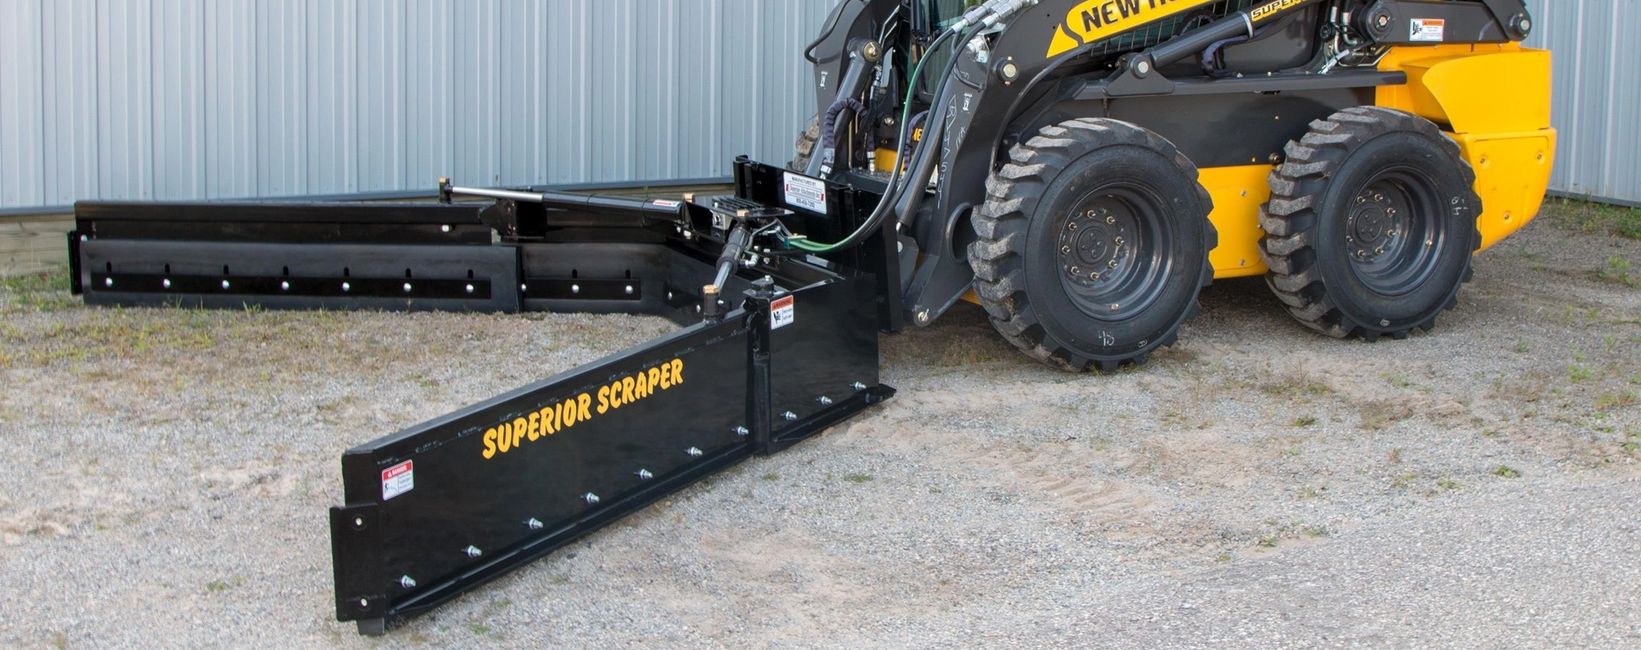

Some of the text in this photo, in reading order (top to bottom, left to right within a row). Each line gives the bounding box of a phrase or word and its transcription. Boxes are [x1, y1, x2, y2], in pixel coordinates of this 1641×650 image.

[1081, 0, 1140, 33] NEW
[482, 358, 684, 460] SUPERIOR SCRAPER
